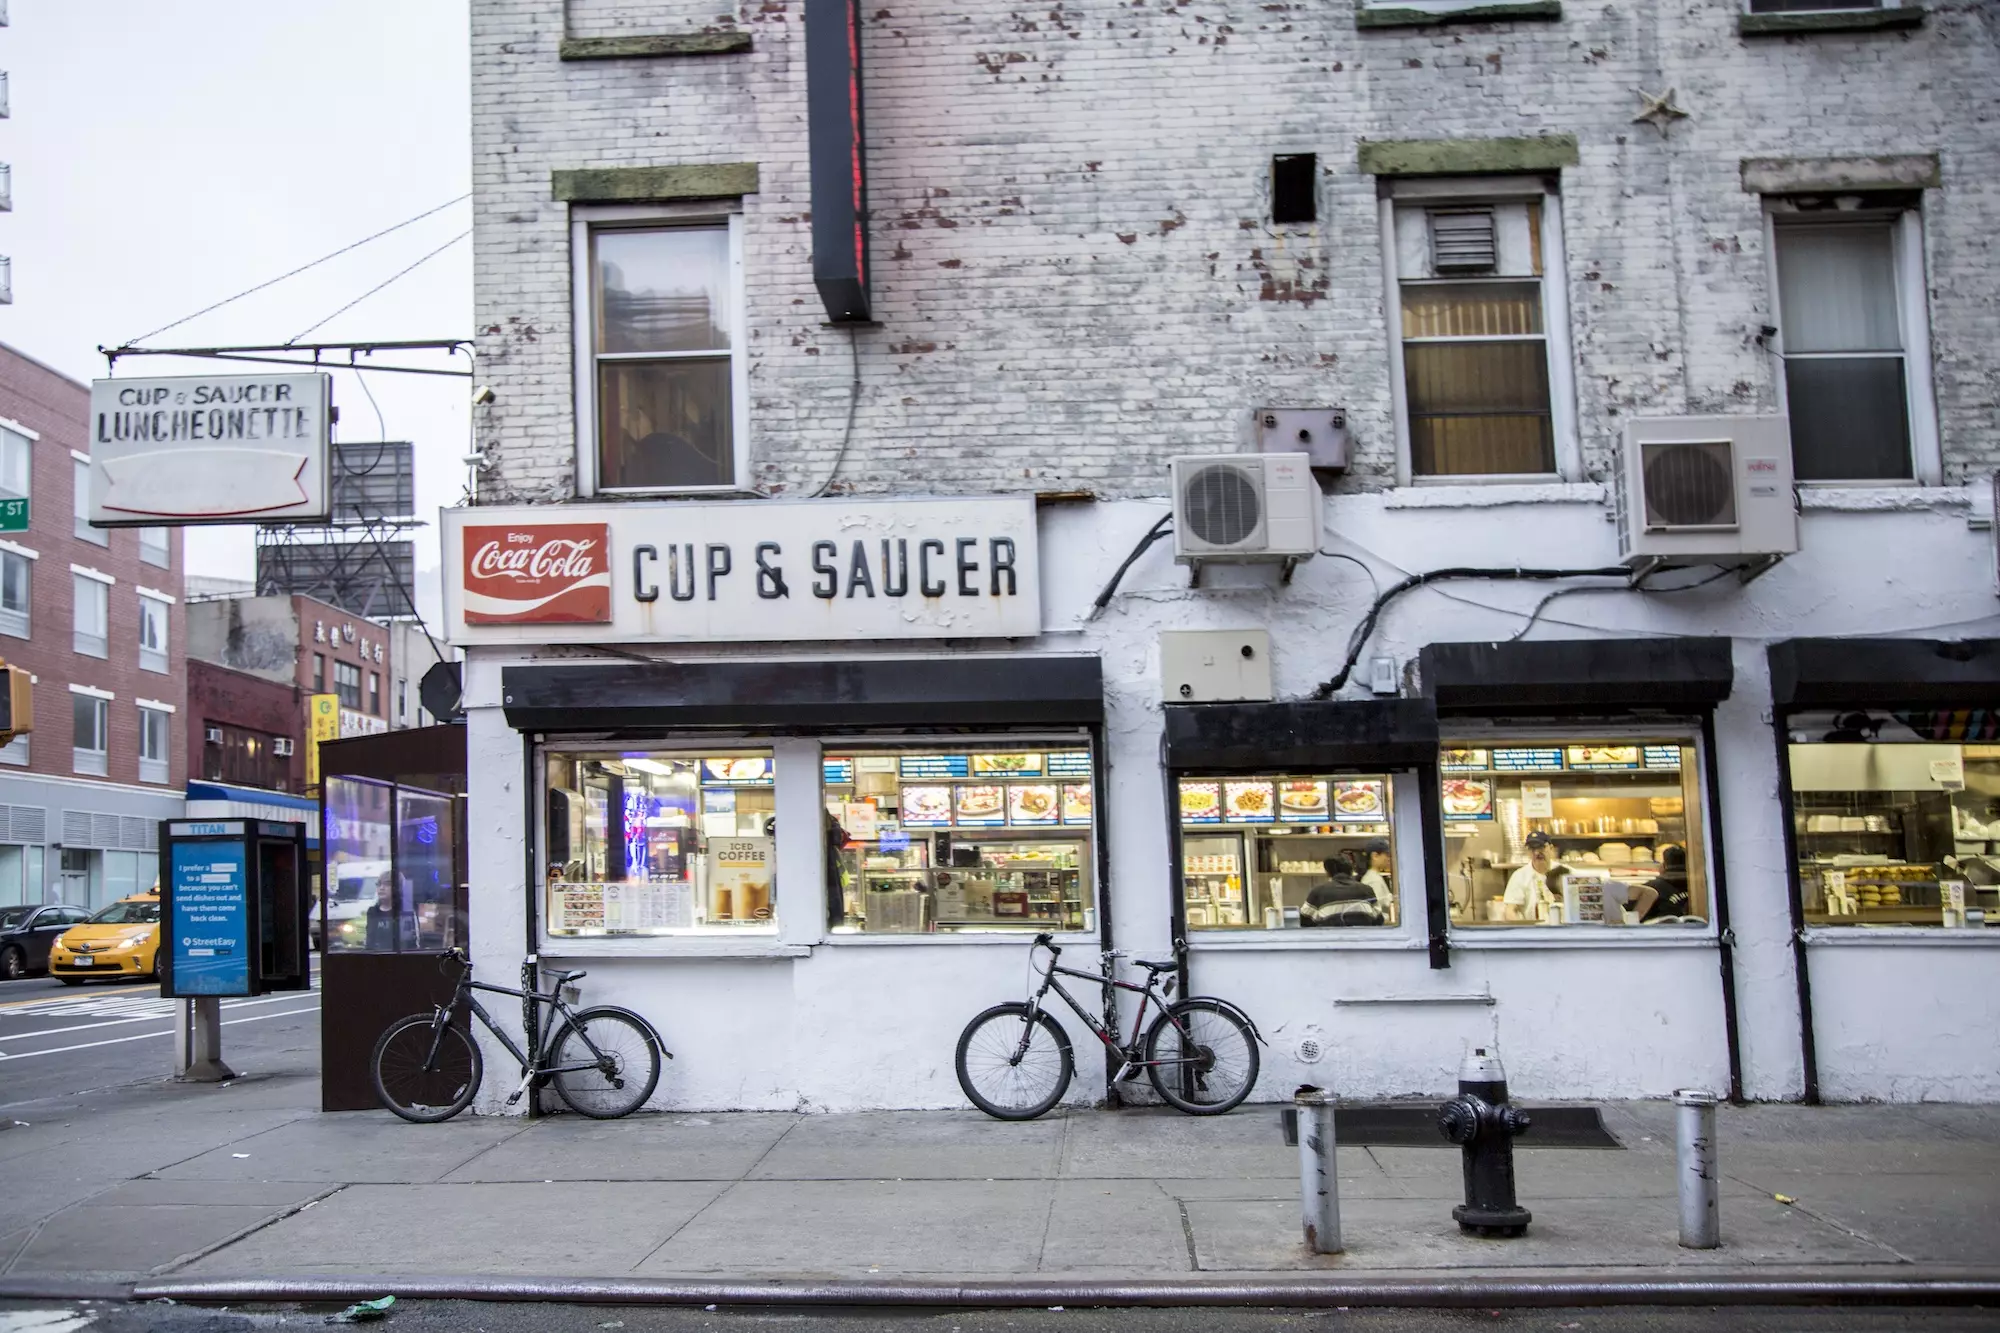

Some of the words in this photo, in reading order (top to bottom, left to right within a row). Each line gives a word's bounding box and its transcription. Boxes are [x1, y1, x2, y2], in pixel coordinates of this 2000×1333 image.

[119, 387, 170, 407] CUP
[192, 383, 292, 406] SAUCER
[97, 405, 311, 443] LUNCHEONETTE
[7, 501, 25, 516] ST
[507, 533, 535, 544] Enjoy
[470, 539, 598, 579] Coca-Cola
[632, 543, 732, 602] CUP
[755, 541, 789, 600] &
[811, 536, 1018, 600] SAUCER
[190, 824, 226, 834] TITAN
[729, 842, 754, 850] ICED
[718, 851, 766, 861] COFFEE
[182, 864, 205, 873] prefer
[179, 884, 208, 892] because
[192, 937, 236, 947] StreetEasy
